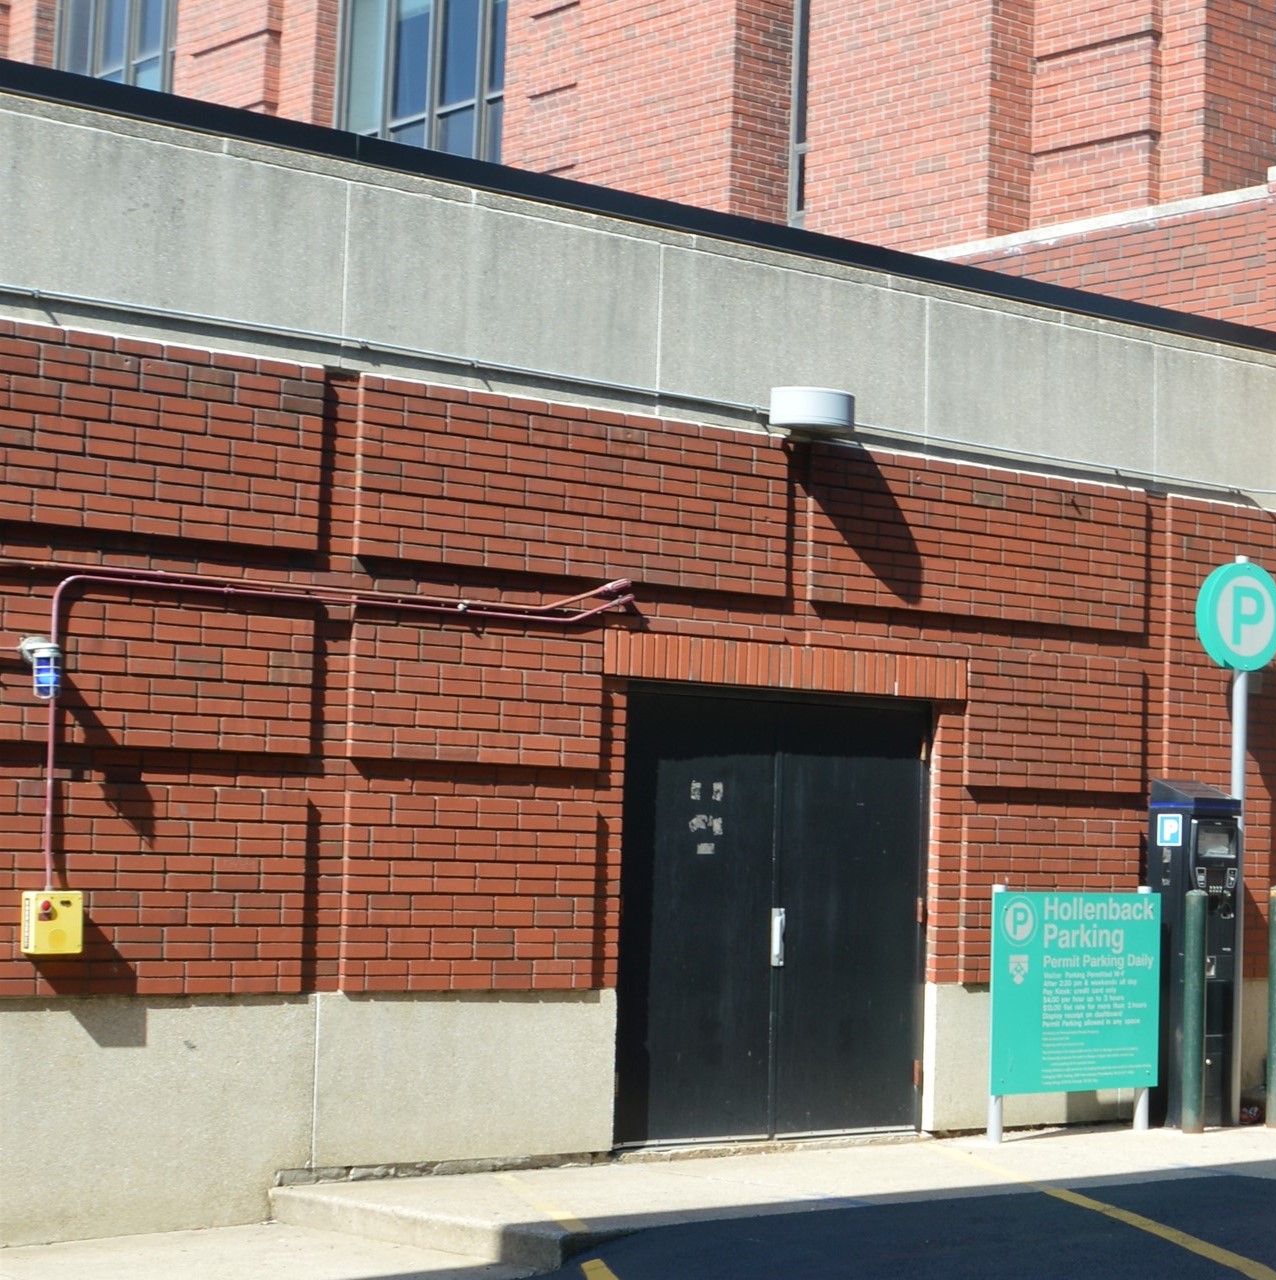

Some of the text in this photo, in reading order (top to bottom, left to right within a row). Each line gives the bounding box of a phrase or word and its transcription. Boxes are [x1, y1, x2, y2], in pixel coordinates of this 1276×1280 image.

[1232, 586, 1265, 646] P
[1163, 819, 1178, 841] P
[1044, 897, 1155, 921] Hollenback
[1012, 907, 1029, 936] P
[1043, 923, 1125, 955] Parking
[1043, 953, 1154, 970] Permit Parking Daily
[1065, 971, 1085, 980] Parking
[1086, 970, 1113, 978] Permitted
[1126, 978, 1137, 987] day
[1043, 988, 1054, 996] Pay
[1073, 987, 1090, 995] credit
[1105, 987, 1117, 995] only
[1061, 996, 1071, 1004] per
[1072, 995, 1085, 1003] hour
[1086, 996, 1095, 1004] up
[1062, 1003, 1073, 1011] flat
[1112, 1002, 1125, 1010] than
[1042, 1010, 1123, 1020] Display receipt on dashboard
[1042, 1020, 1061, 1028] Permit
[1061, 1019, 1083, 1028] Parking
[1083, 1019, 1105, 1027] allowed
[1112, 1019, 1123, 1027] any
